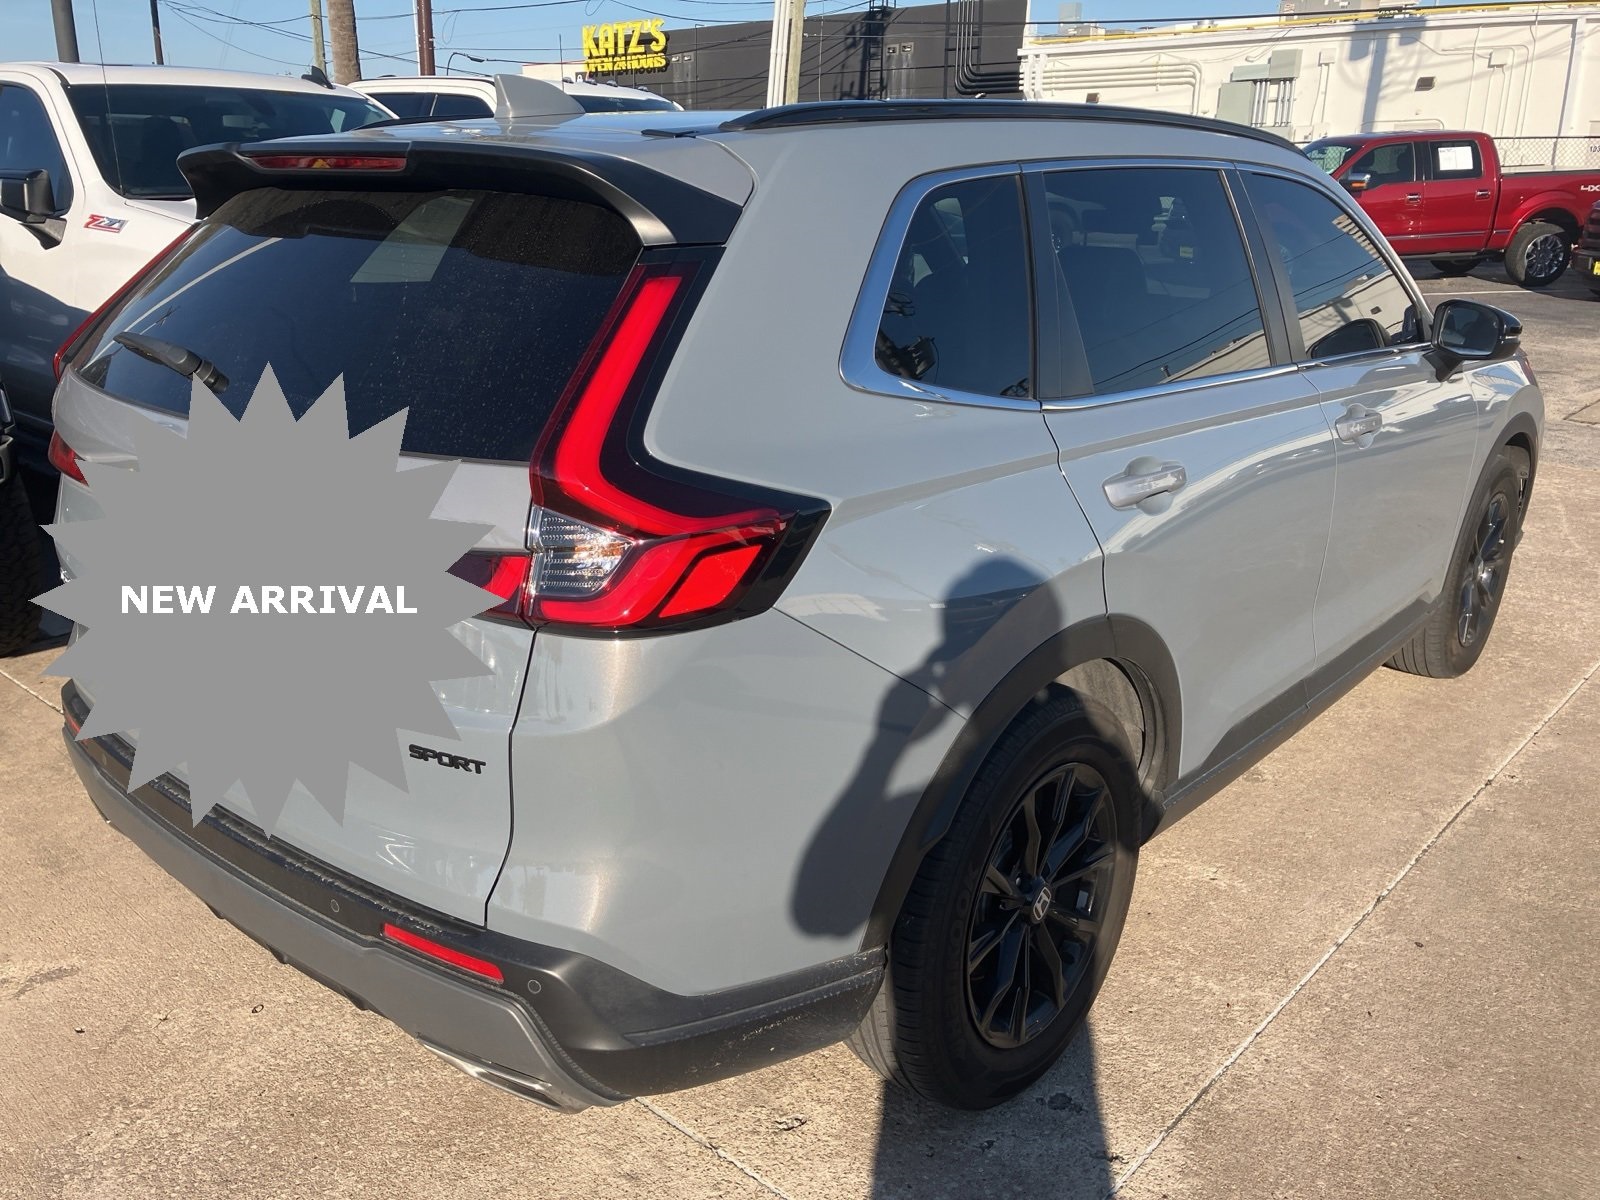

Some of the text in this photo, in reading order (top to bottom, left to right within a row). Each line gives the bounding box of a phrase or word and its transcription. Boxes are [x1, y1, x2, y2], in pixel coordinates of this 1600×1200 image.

[582, 18, 667, 57] KATZ'S
[584, 53, 667, 72] OPEN 24 HOURS
[83, 213, 128, 233] Z71
[408, 743, 486, 775] SPORT
